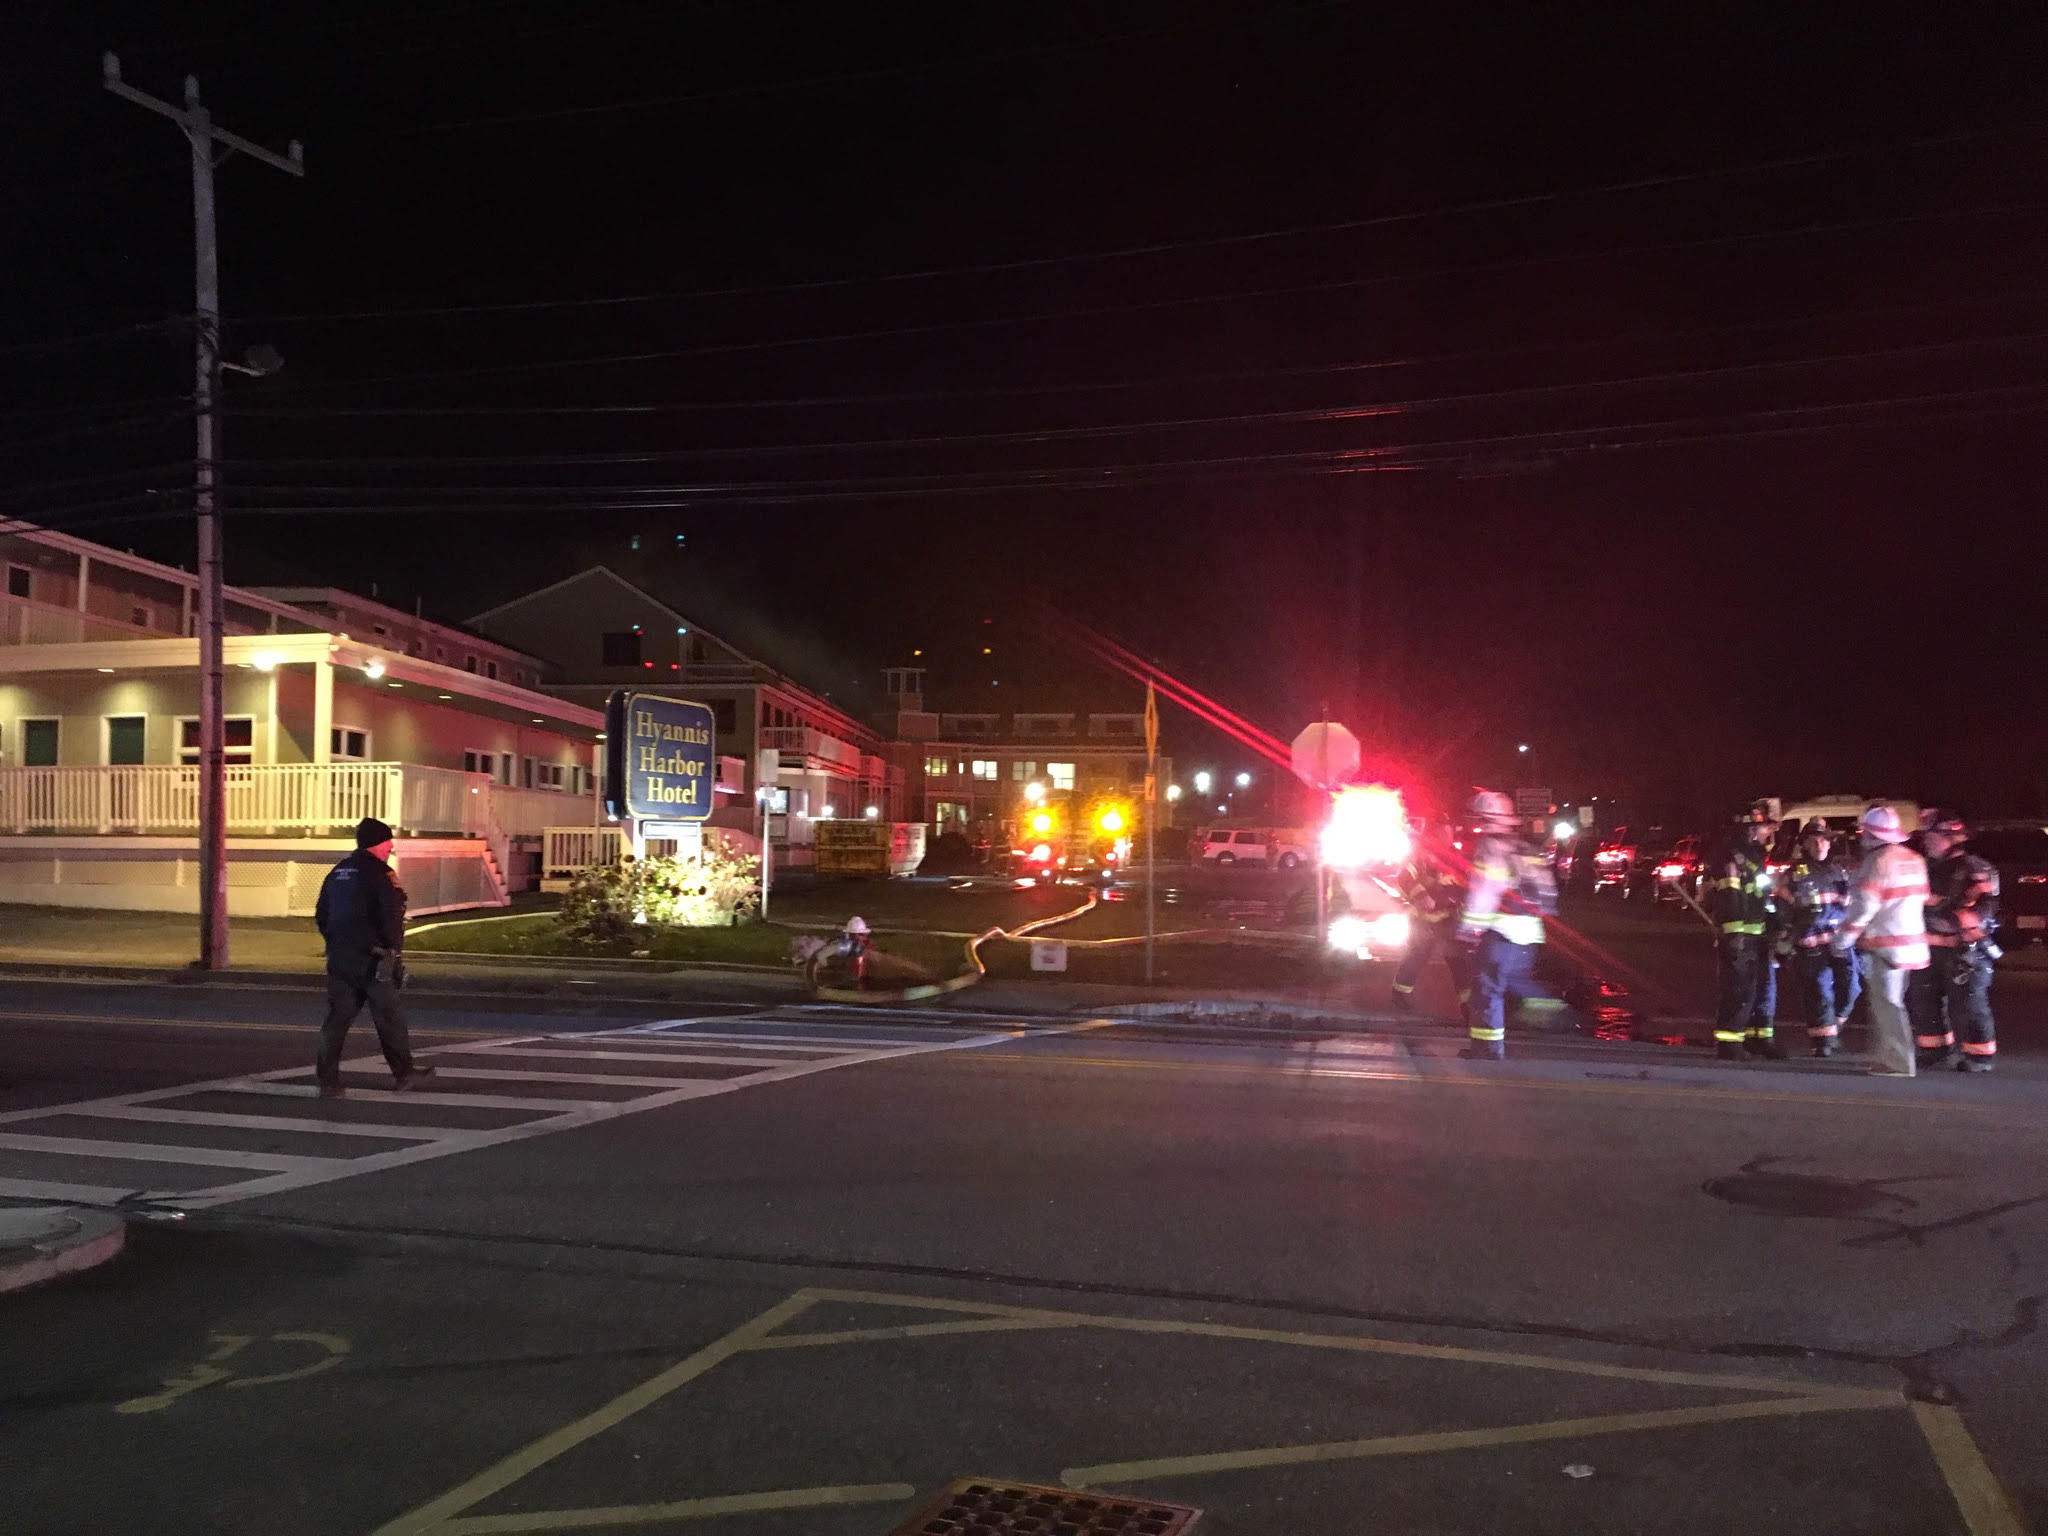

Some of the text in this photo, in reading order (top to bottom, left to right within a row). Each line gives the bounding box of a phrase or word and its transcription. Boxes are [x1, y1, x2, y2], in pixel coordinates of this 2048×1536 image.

[636, 711, 709, 746] Hyannis
[639, 746, 705, 776] Harbor
[647, 776, 697, 804] Hotel
